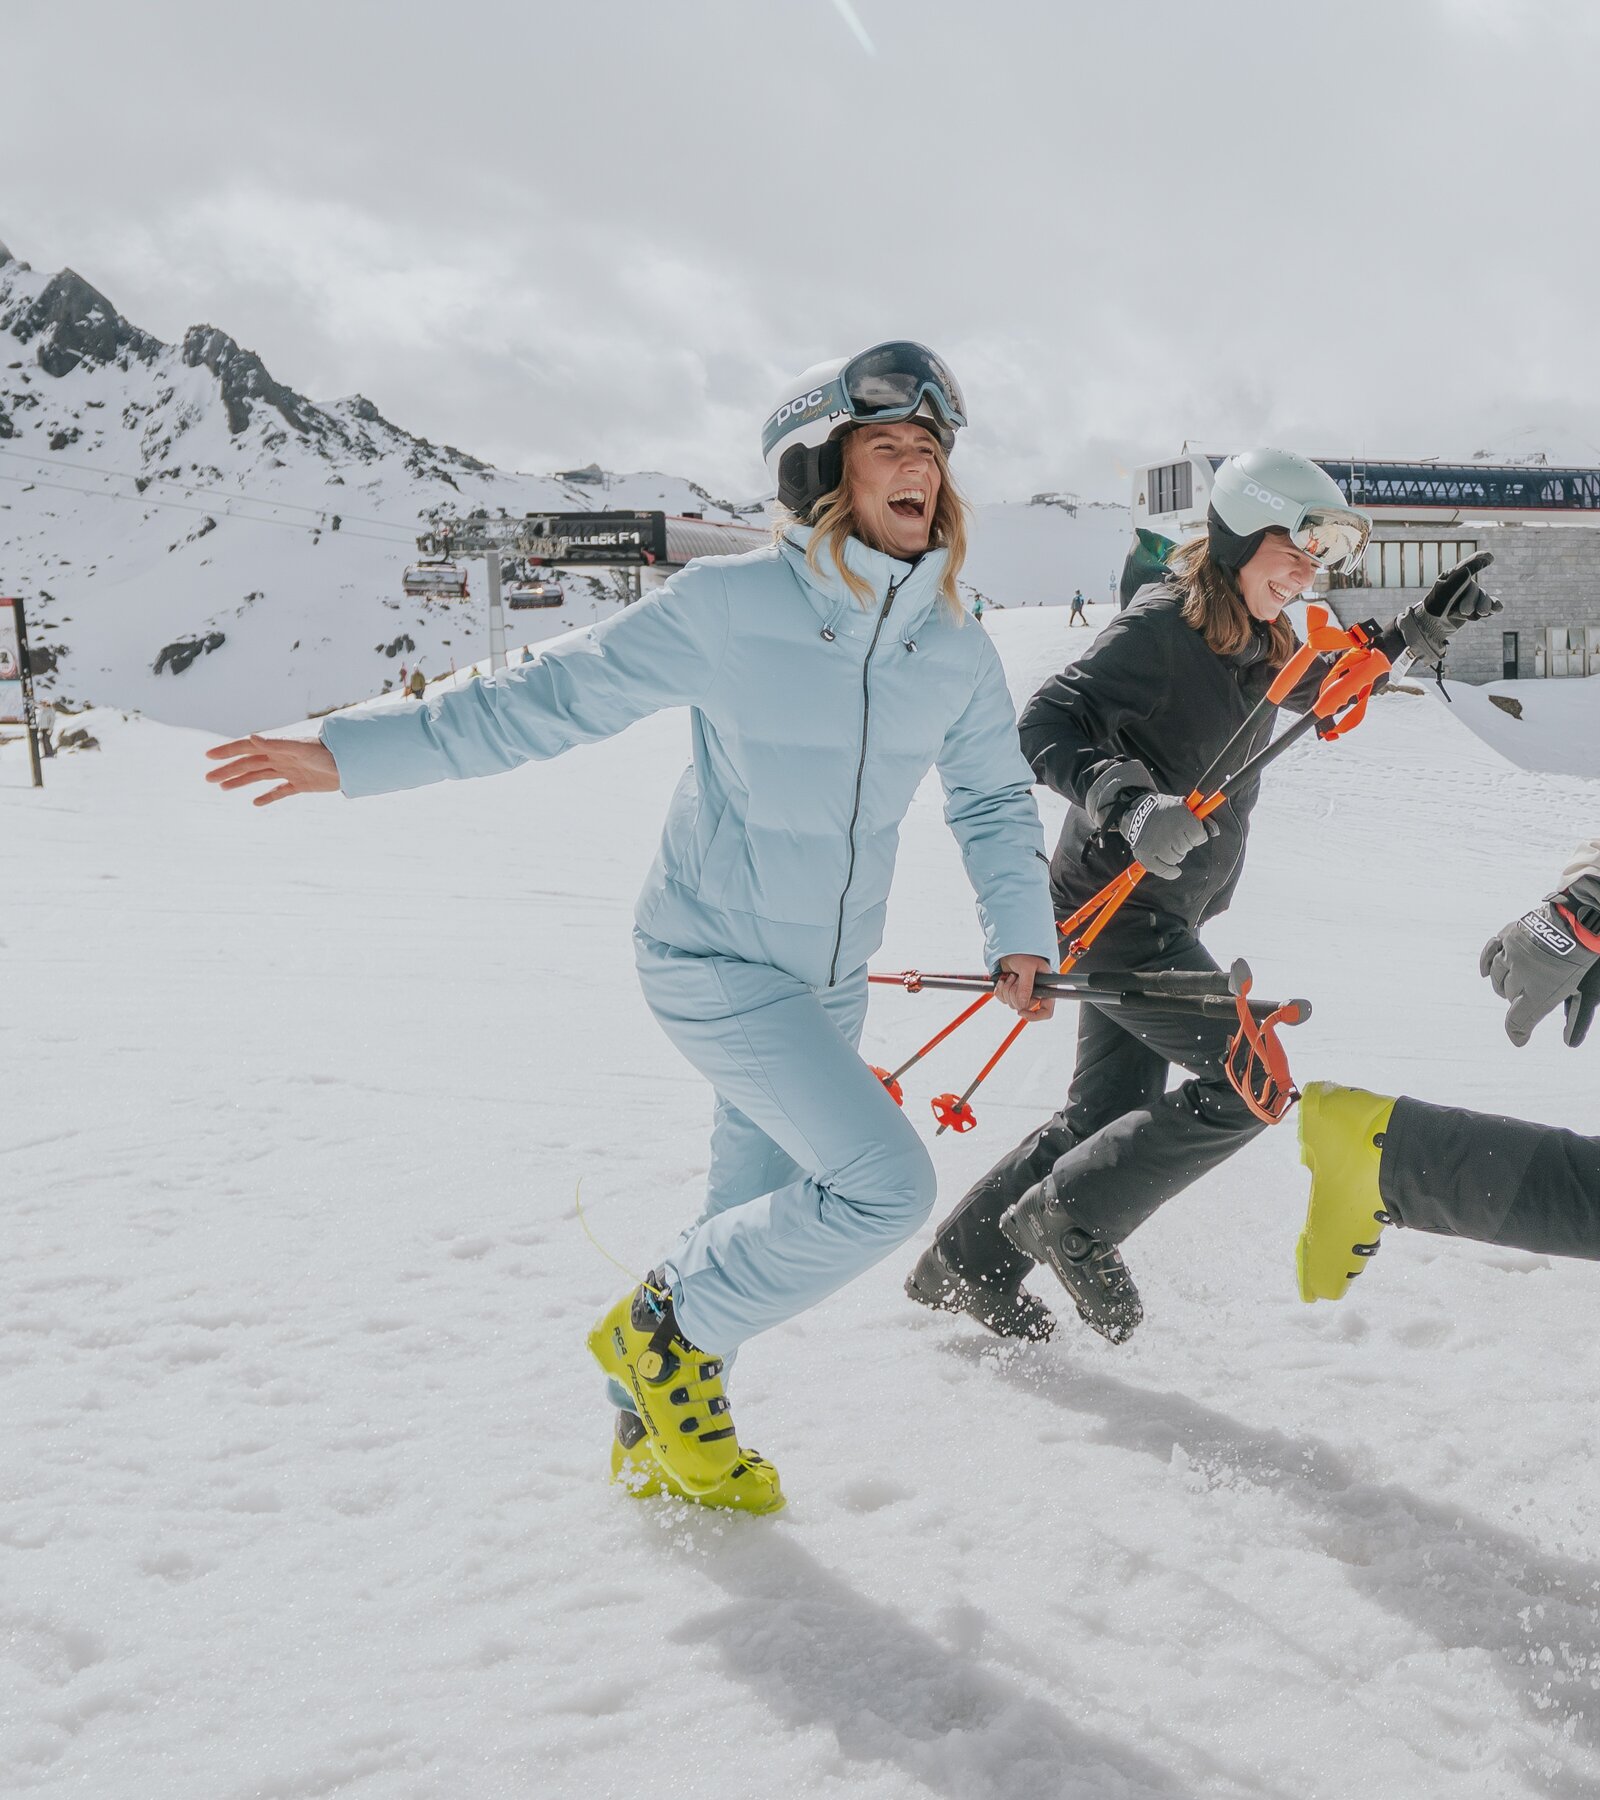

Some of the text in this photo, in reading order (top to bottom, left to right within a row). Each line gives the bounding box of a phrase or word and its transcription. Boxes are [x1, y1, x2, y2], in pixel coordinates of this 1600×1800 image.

[618, 531, 641, 545] F1
[1524, 914, 1572, 950] SPYDER
[627, 1363, 660, 1437] FISCHER
